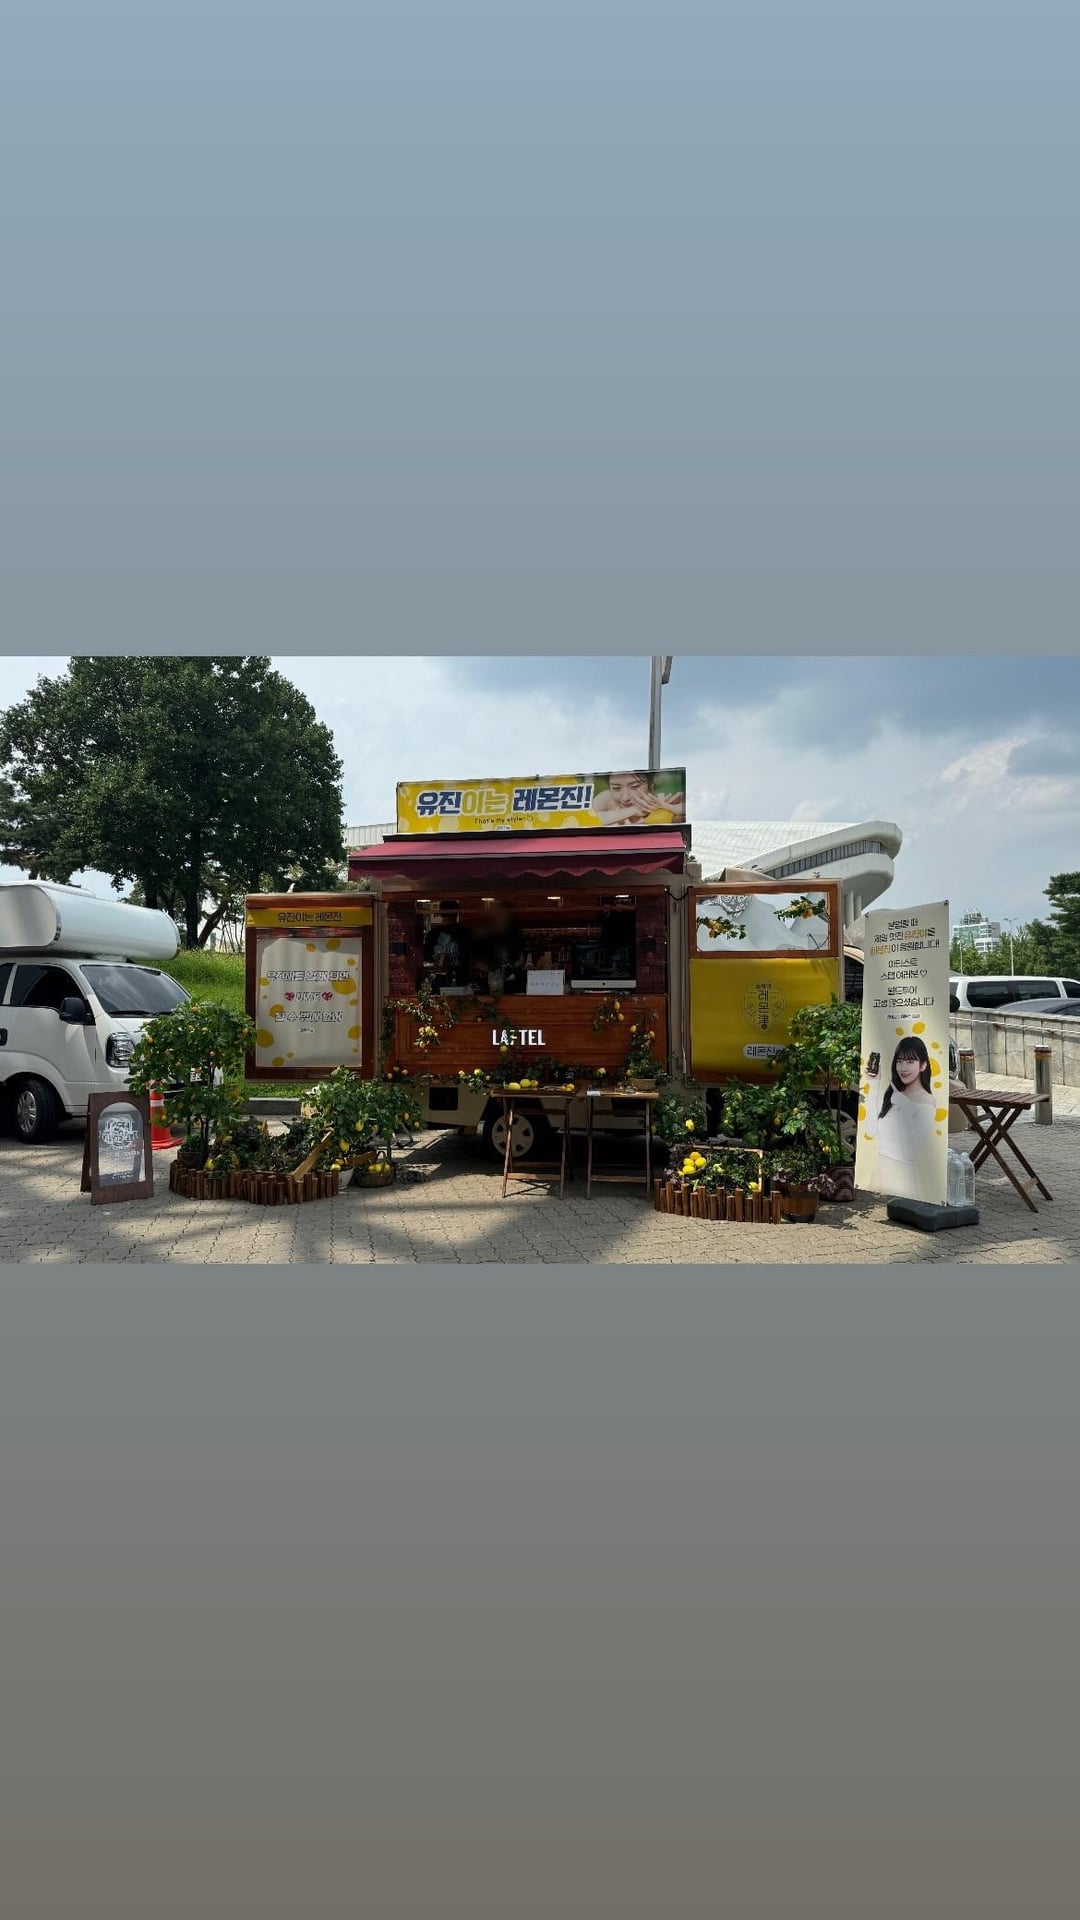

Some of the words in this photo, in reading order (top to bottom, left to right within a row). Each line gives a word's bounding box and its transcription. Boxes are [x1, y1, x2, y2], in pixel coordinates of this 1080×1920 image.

[416, 790, 509, 815] 유진이는
[513, 786, 592, 812] 레몬진!
[277, 912, 313, 922] 유진이는
[315, 911, 342, 922] 레몬진
[889, 932, 904, 941] 멋진
[888, 957, 918, 968] 아티스트
[896, 969, 919, 979] 여러분
[887, 985, 917, 995] 월드투어
